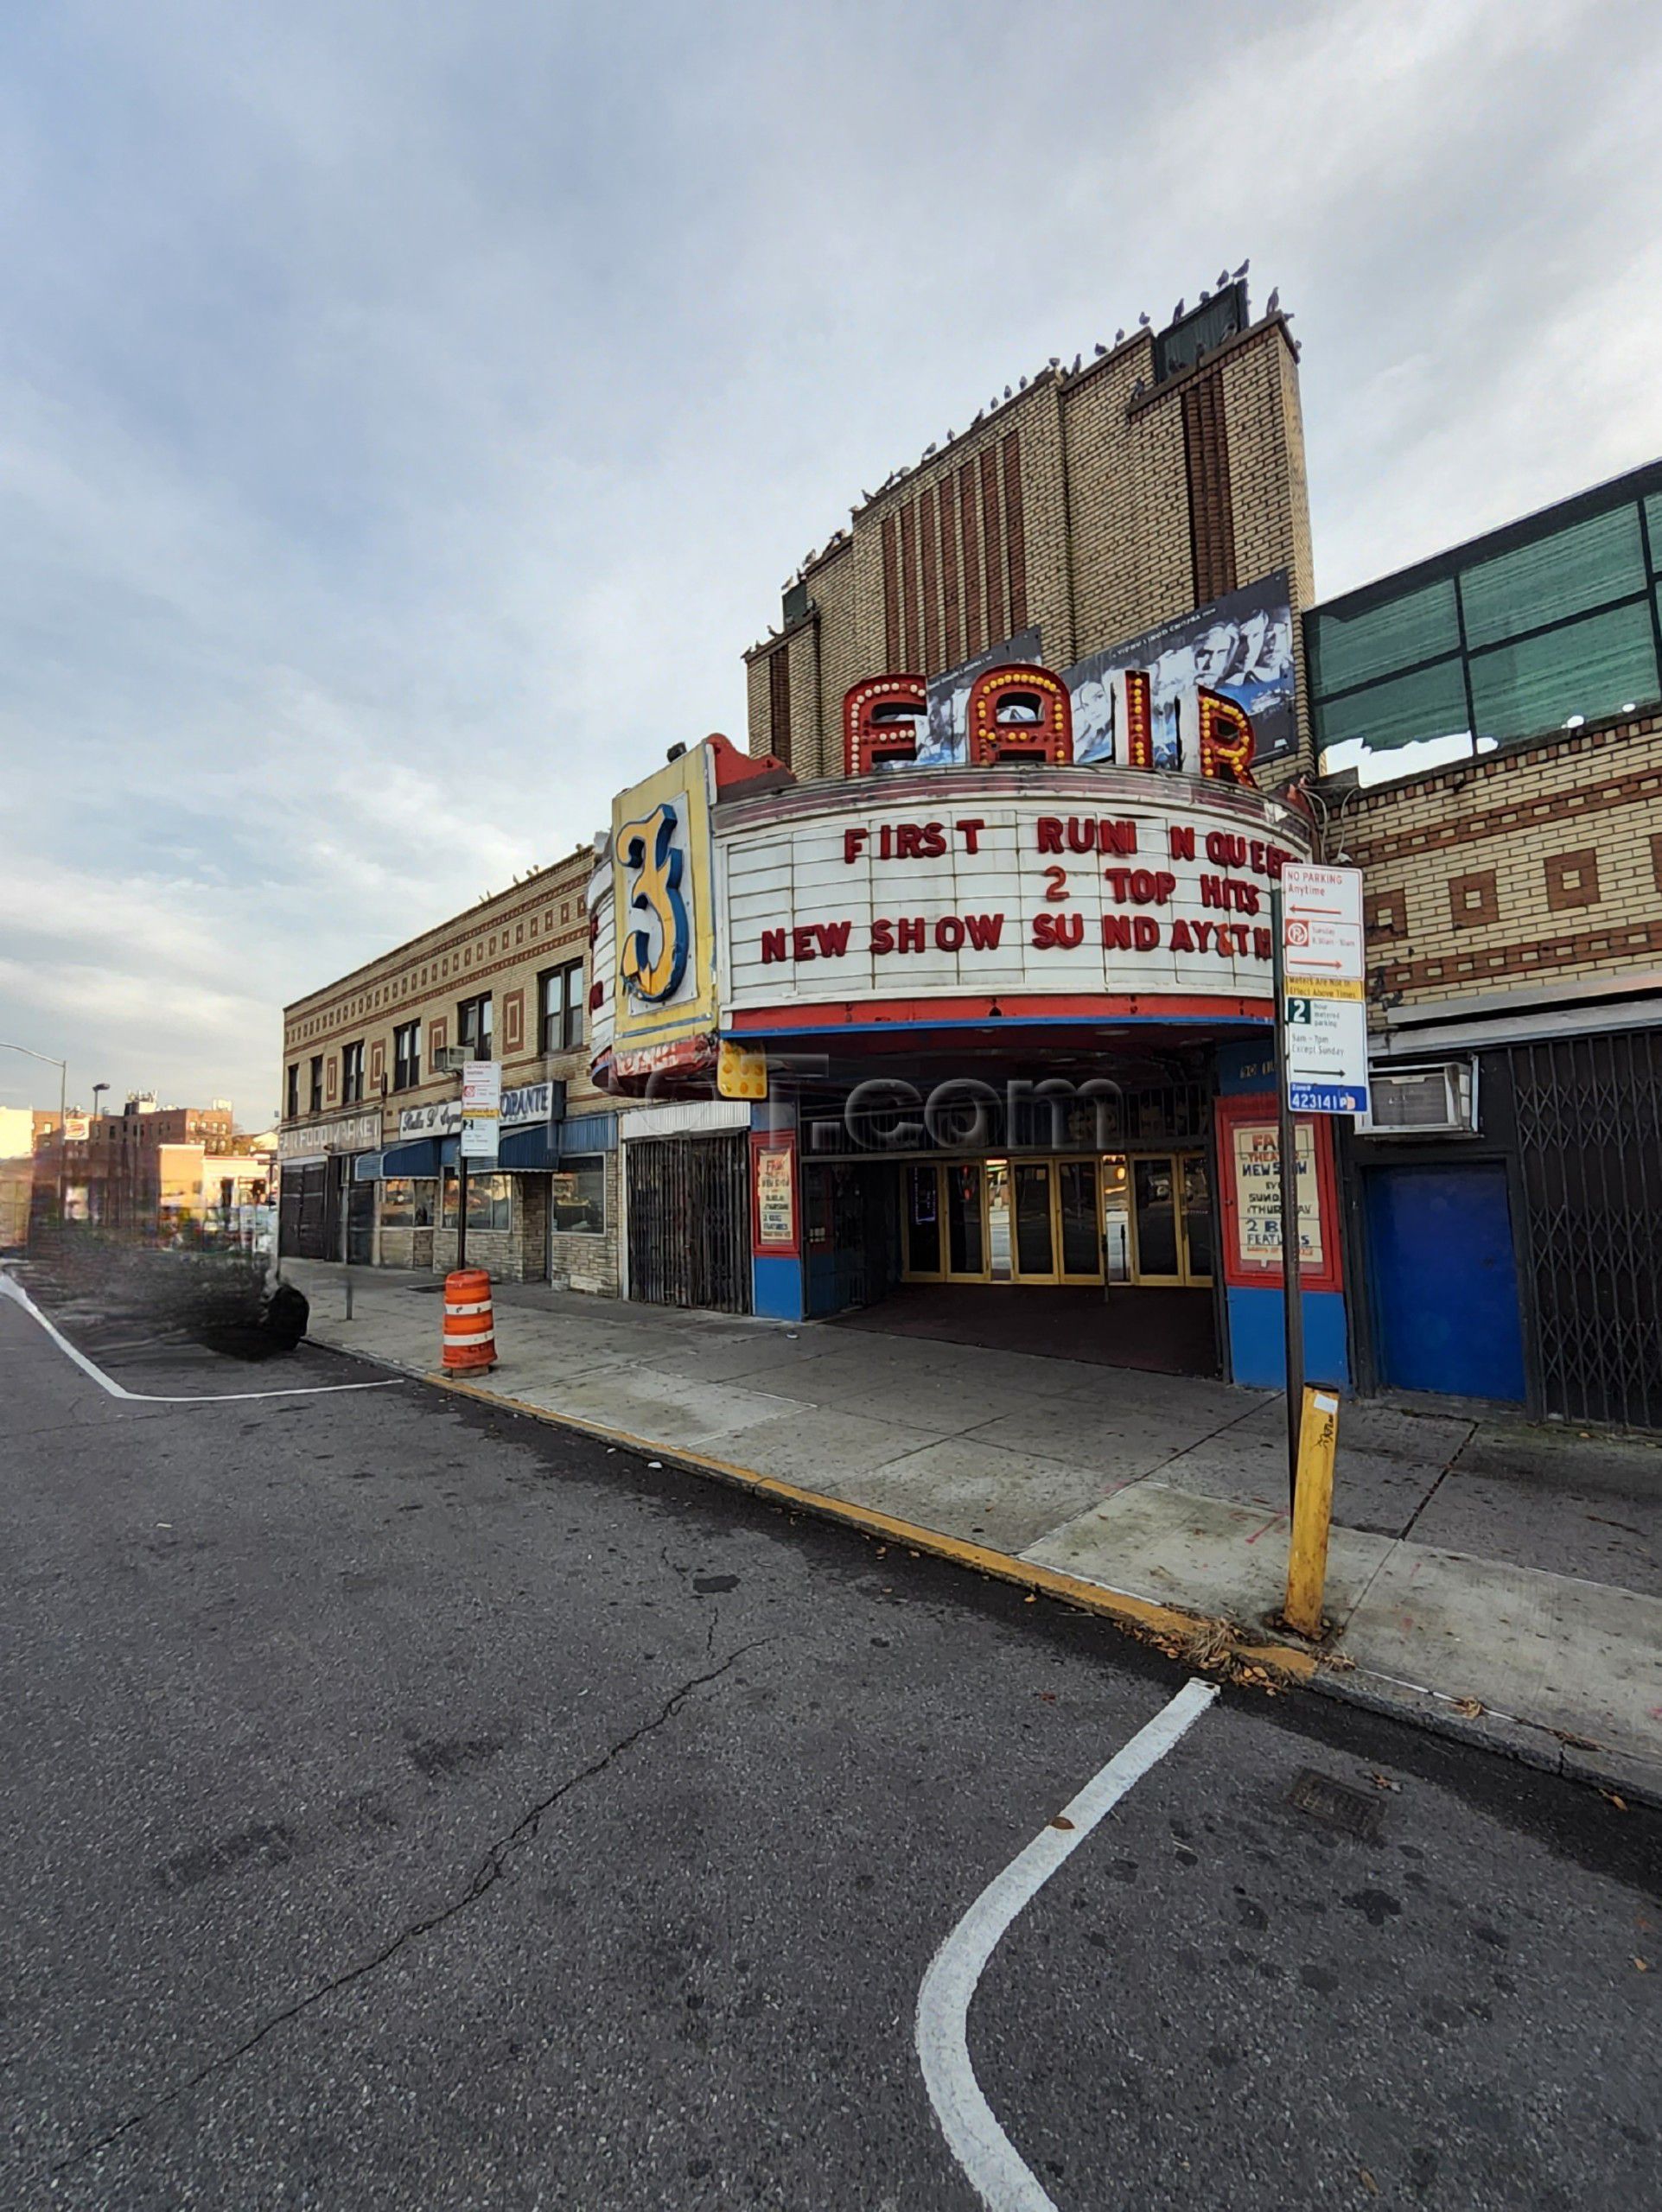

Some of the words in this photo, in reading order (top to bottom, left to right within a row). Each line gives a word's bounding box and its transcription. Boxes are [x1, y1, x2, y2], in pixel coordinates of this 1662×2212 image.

[844, 663, 1258, 789] FAIR
[844, 819, 984, 864] FIRST
[1288, 871, 1300, 881] NO
[1303, 872, 1342, 885] PARKING
[1044, 866, 1070, 902] 2
[1105, 868, 1176, 906] TOP
[1200, 874, 1259, 916] HITS
[1289, 884, 1325, 896] Anytime
[761, 921, 851, 963] NEW
[869, 913, 1003, 955] SHOW
[1293, 999, 1306, 1023] 2
[1319, 1045, 1345, 1056] Sunday
[1291, 1093, 1337, 1110] 423141
[1242, 1164, 1270, 1177] NEW
[1245, 1219, 1258, 1231] 2
